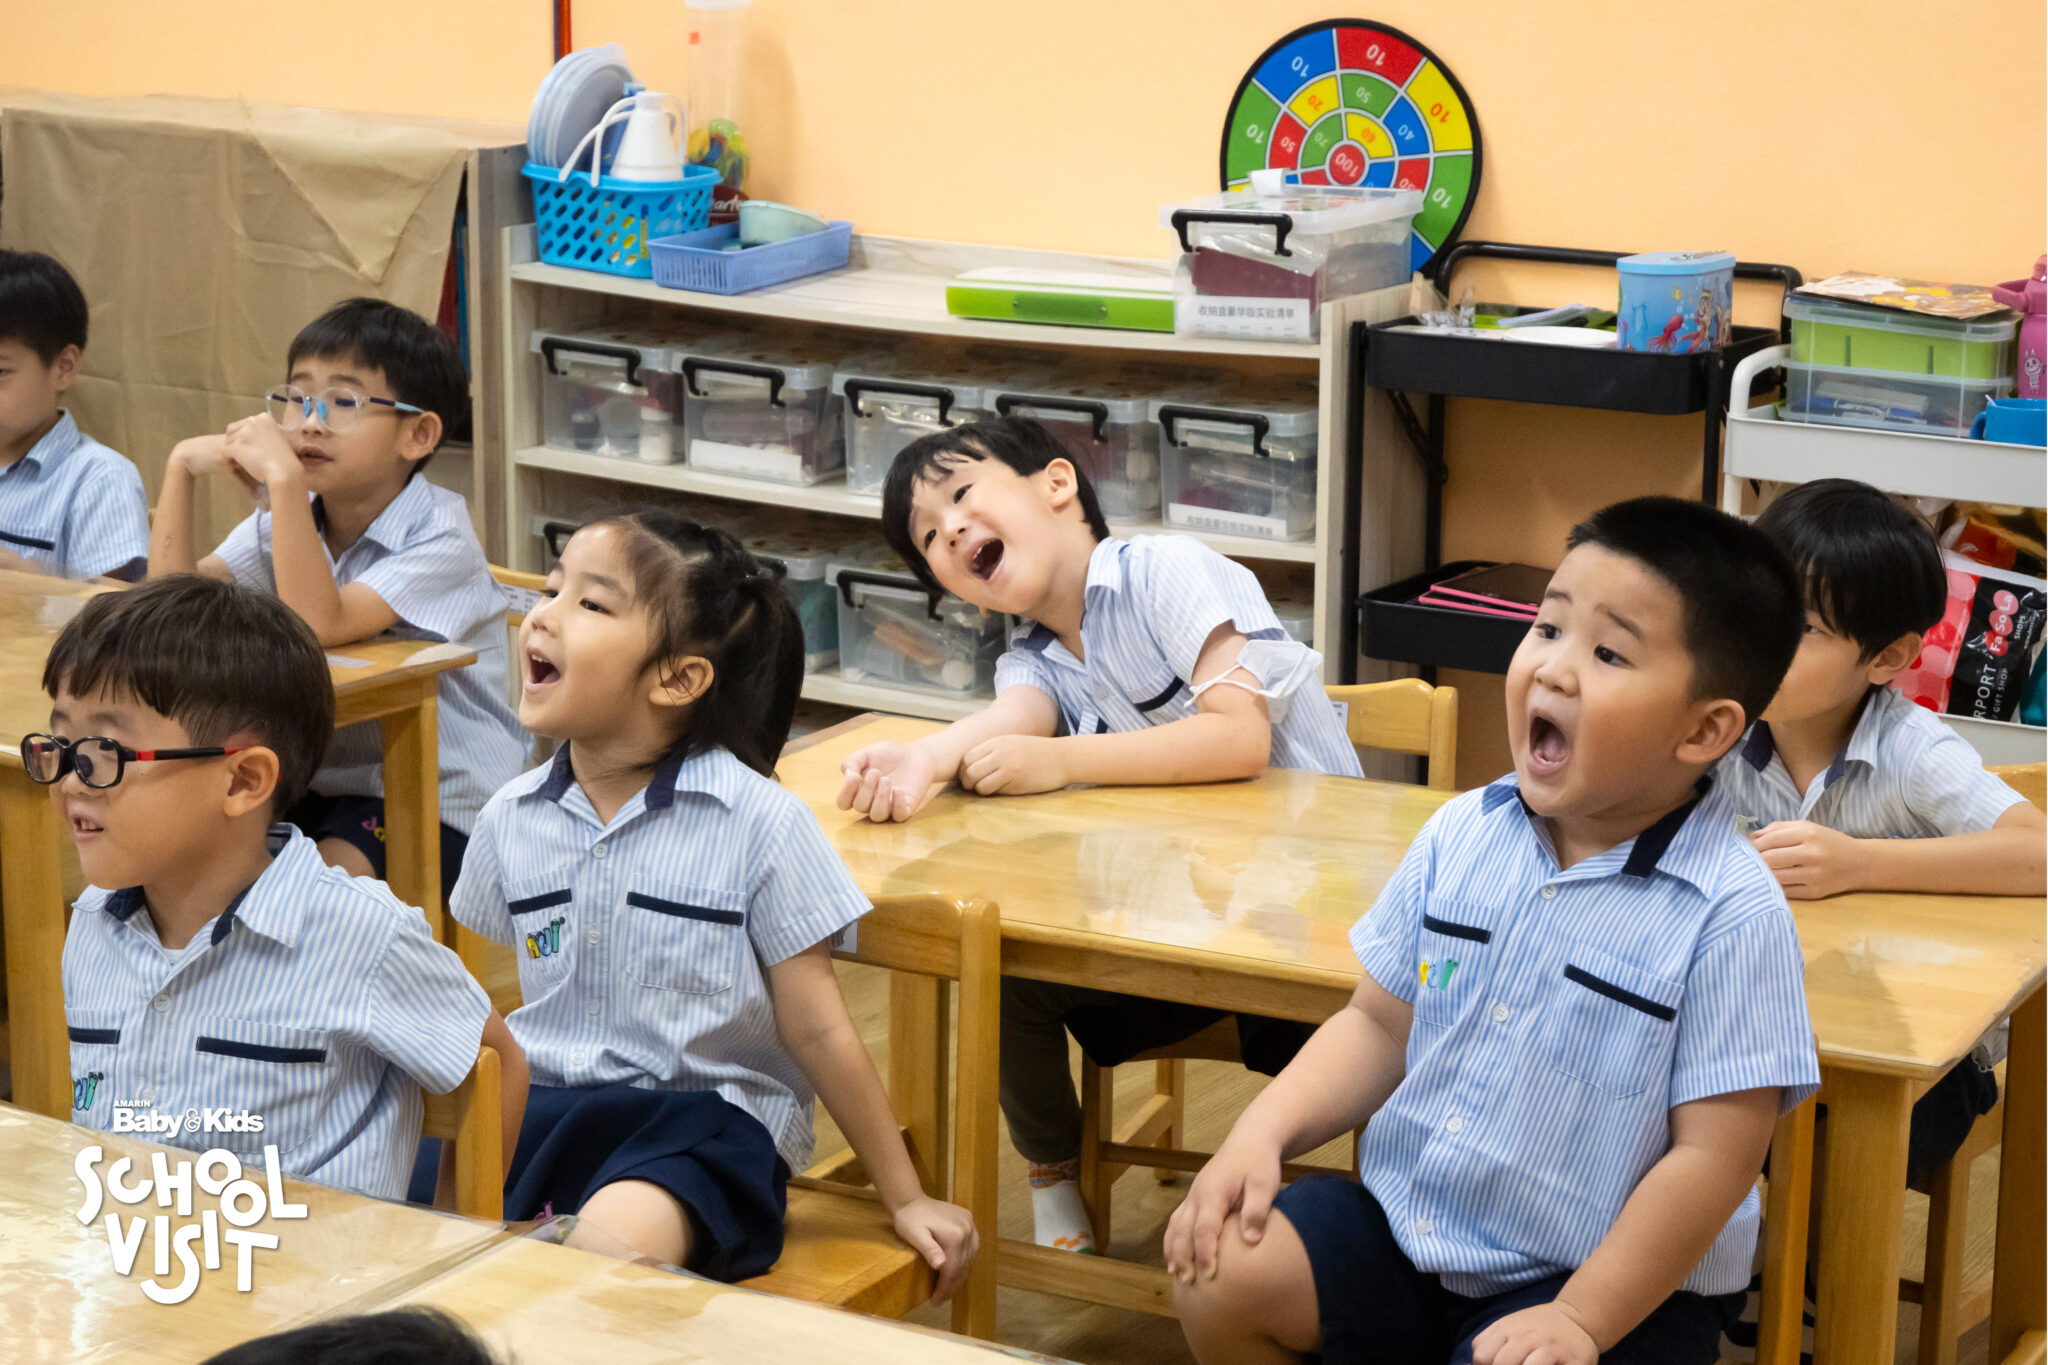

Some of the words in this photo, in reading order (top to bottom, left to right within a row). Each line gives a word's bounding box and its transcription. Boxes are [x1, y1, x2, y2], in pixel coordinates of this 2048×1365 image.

[1366, 44, 1387, 66] 10
[1291, 56, 1310, 78] 10
[1307, 94, 1324, 112] 20
[1355, 86, 1372, 104] 50
[1430, 102, 1451, 124] 10
[1246, 124, 1265, 144] 10
[1314, 131, 1330, 147] 70
[1398, 124, 1415, 141] 40
[1280, 136, 1297, 153] 50
[1335, 152, 1360, 178] 100
[1432, 187, 1452, 209] 10
[2013, 615, 2026, 639] SHOPS
[1997, 668, 2008, 691] SHOP
[1993, 694, 2003, 713] GIFT
